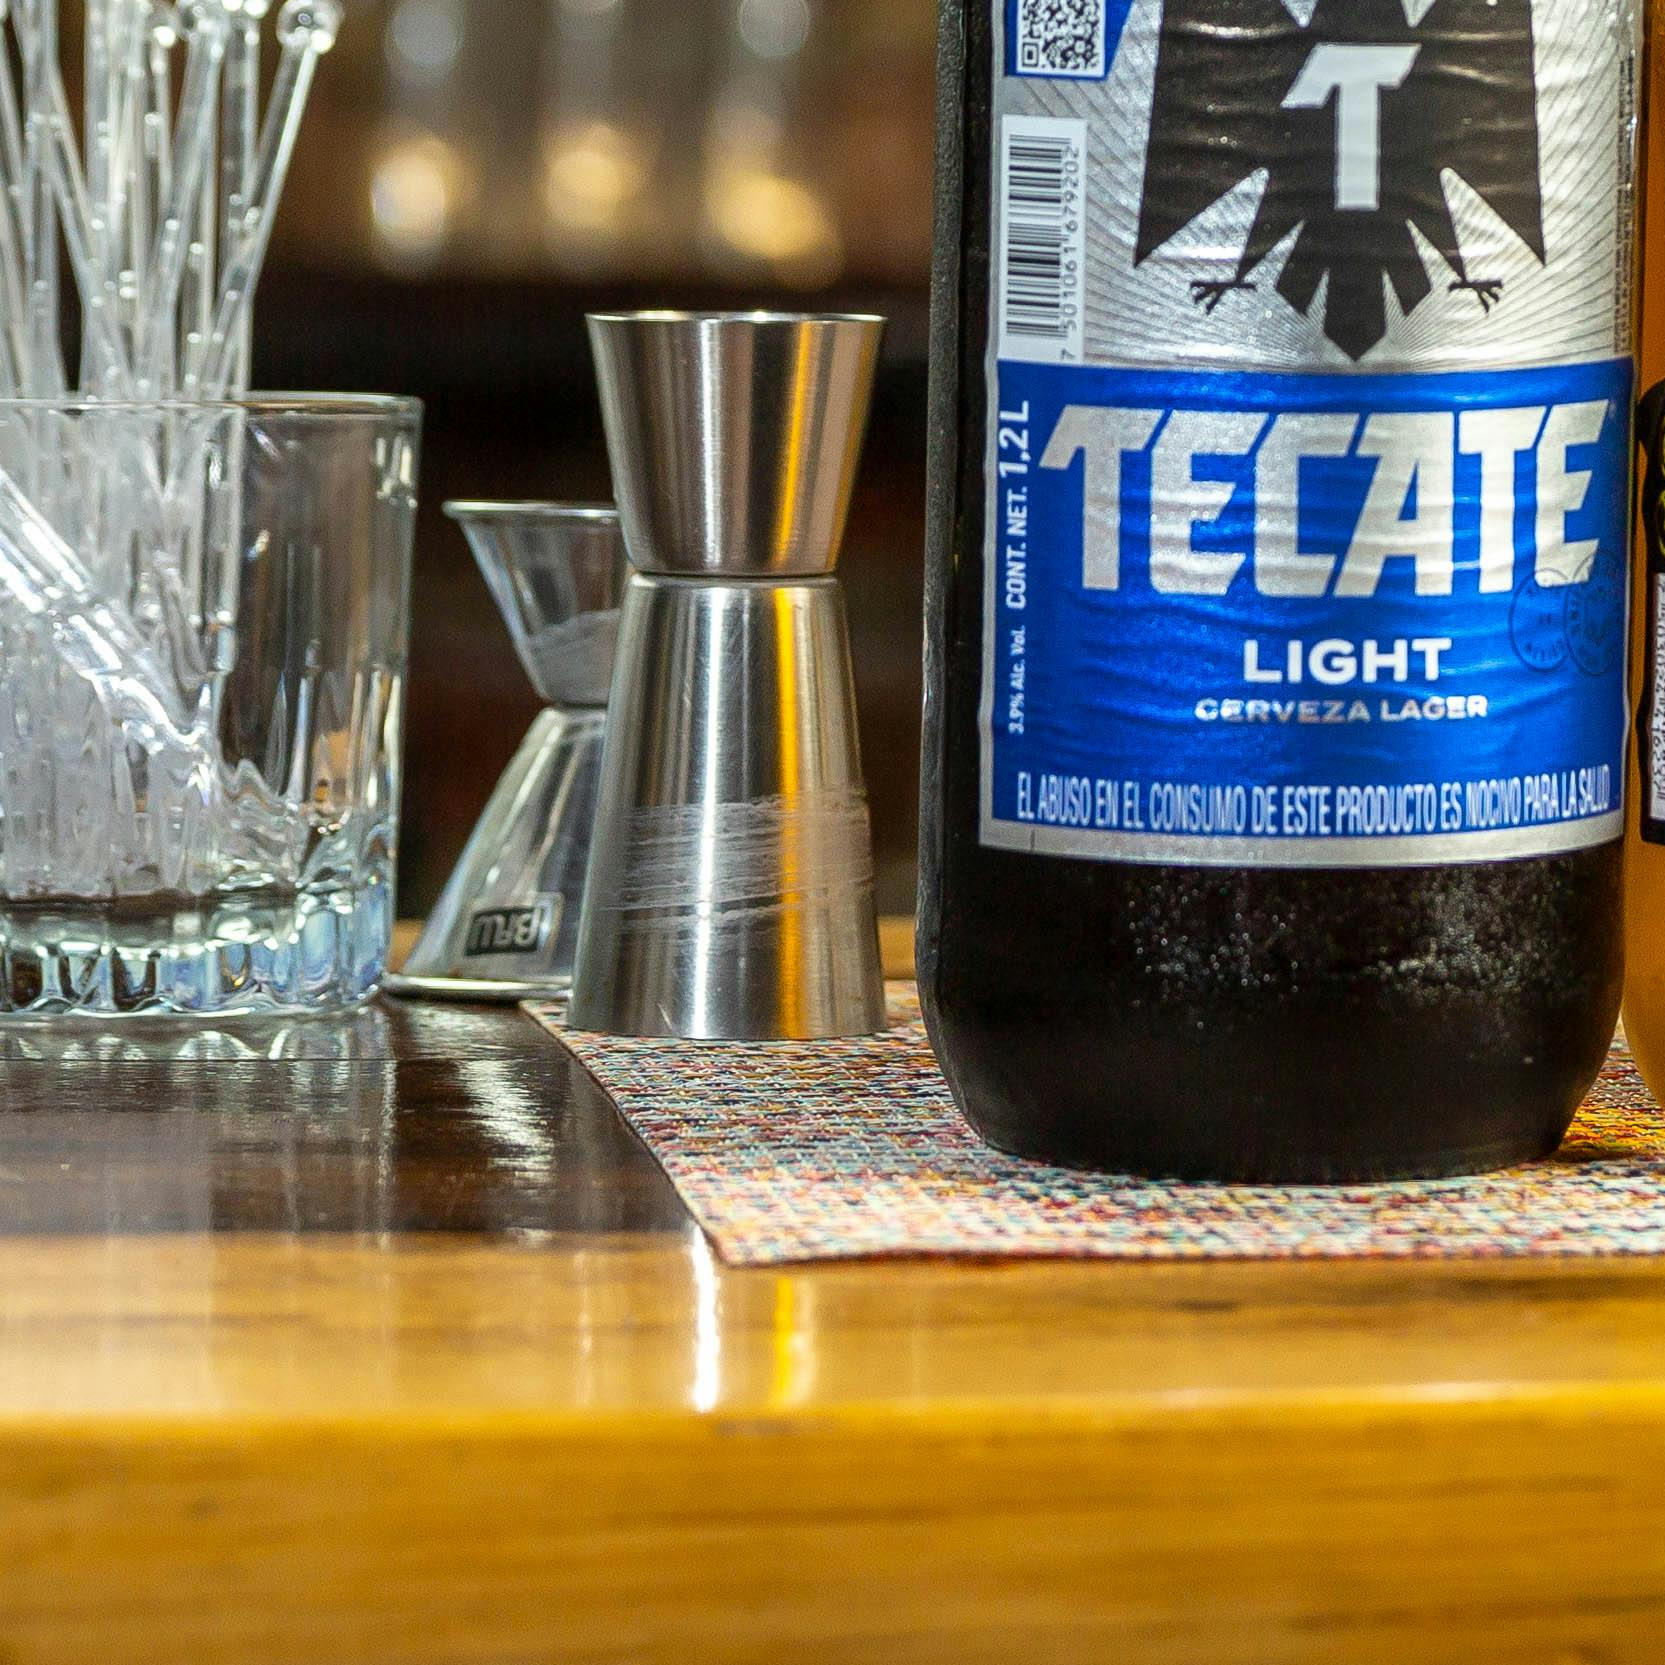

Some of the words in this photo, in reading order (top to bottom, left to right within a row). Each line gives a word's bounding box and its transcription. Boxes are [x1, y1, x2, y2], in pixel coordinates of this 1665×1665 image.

[999, 400, 1030, 422] L
[1005, 486, 1029, 537] NET.
[1039, 398, 1610, 598] TECATE
[1005, 542, 1028, 610] CONT.
[1243, 638, 1452, 684] LIGHT
[1194, 696, 1372, 723] CERVEZA
[1380, 694, 1489, 721] LAGER
[1017, 771, 1035, 820] EL
[1038, 774, 1092, 826] ABUSO
[1095, 778, 1119, 829] EN
[1122, 780, 1145, 830] EL
[1149, 781, 1247, 833] CONSUMO
[1251, 784, 1279, 835] DE
[1282, 784, 1332, 835] ESTE
[1335, 783, 1437, 835] PRODUCTO
[1440, 781, 1463, 831] ES
[1465, 776, 1522, 828] NOCIVO
[1523, 772, 1560, 822] PARA
[1561, 769, 1577, 817] LA
[1578, 763, 1611, 816] SALUD
